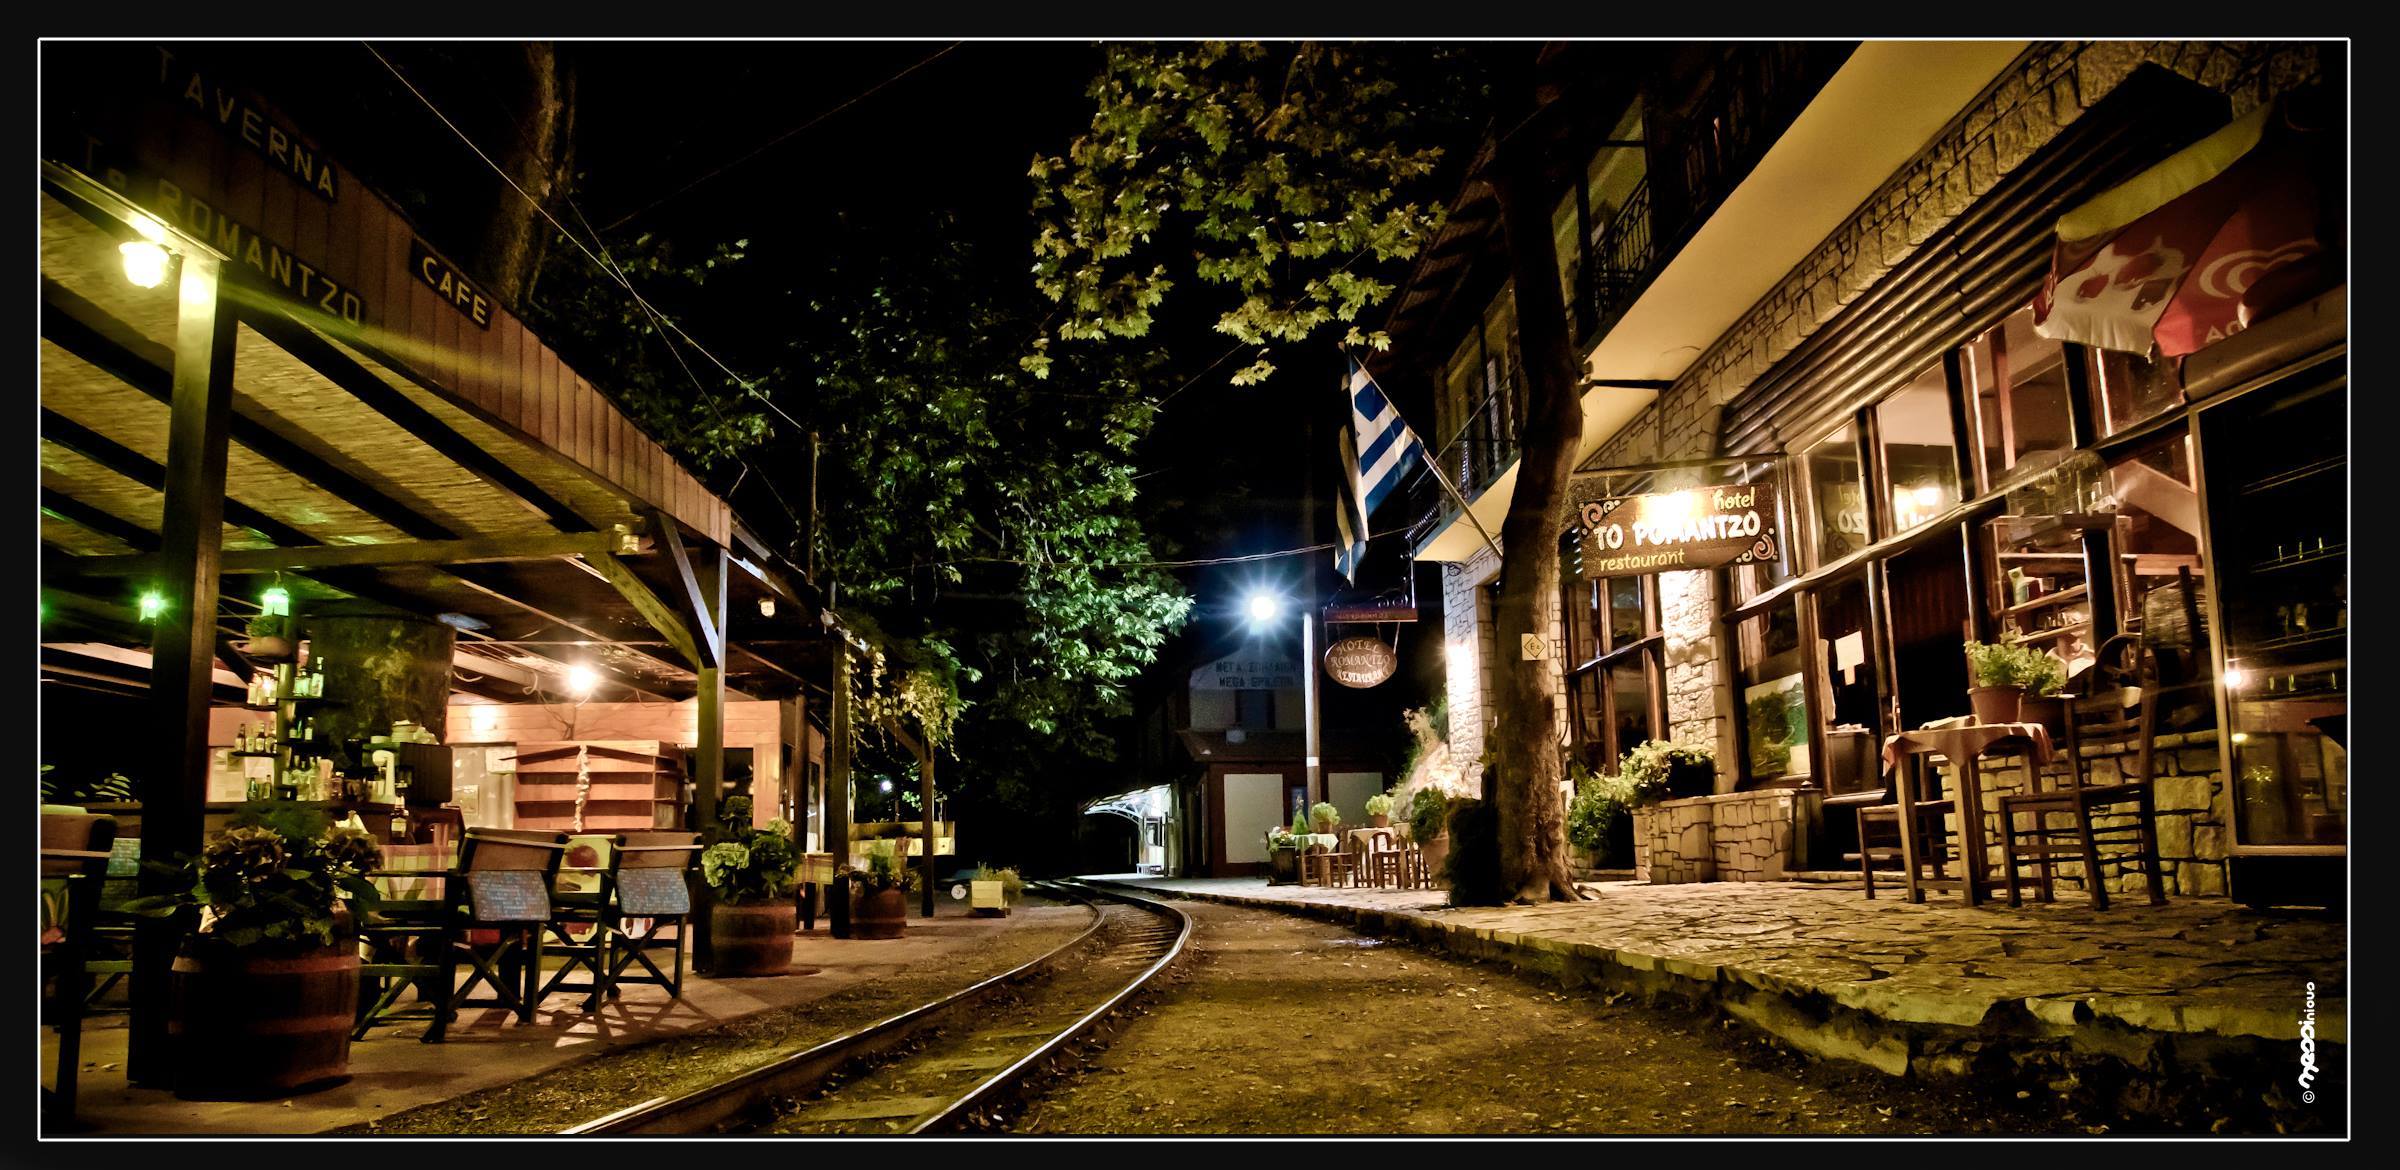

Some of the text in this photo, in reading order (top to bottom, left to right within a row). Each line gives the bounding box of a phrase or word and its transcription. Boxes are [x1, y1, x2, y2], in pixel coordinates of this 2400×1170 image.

[157, 46, 335, 199] TAVERNA
[158, 178, 361, 326] ROMANTZO
[422, 256, 487, 325] CAFE
[1713, 486, 1755, 511] hotel
[1593, 522, 1624, 550] TO
[1600, 550, 1685, 572] restaurant
[1336, 639, 1380, 655] HOTEL
